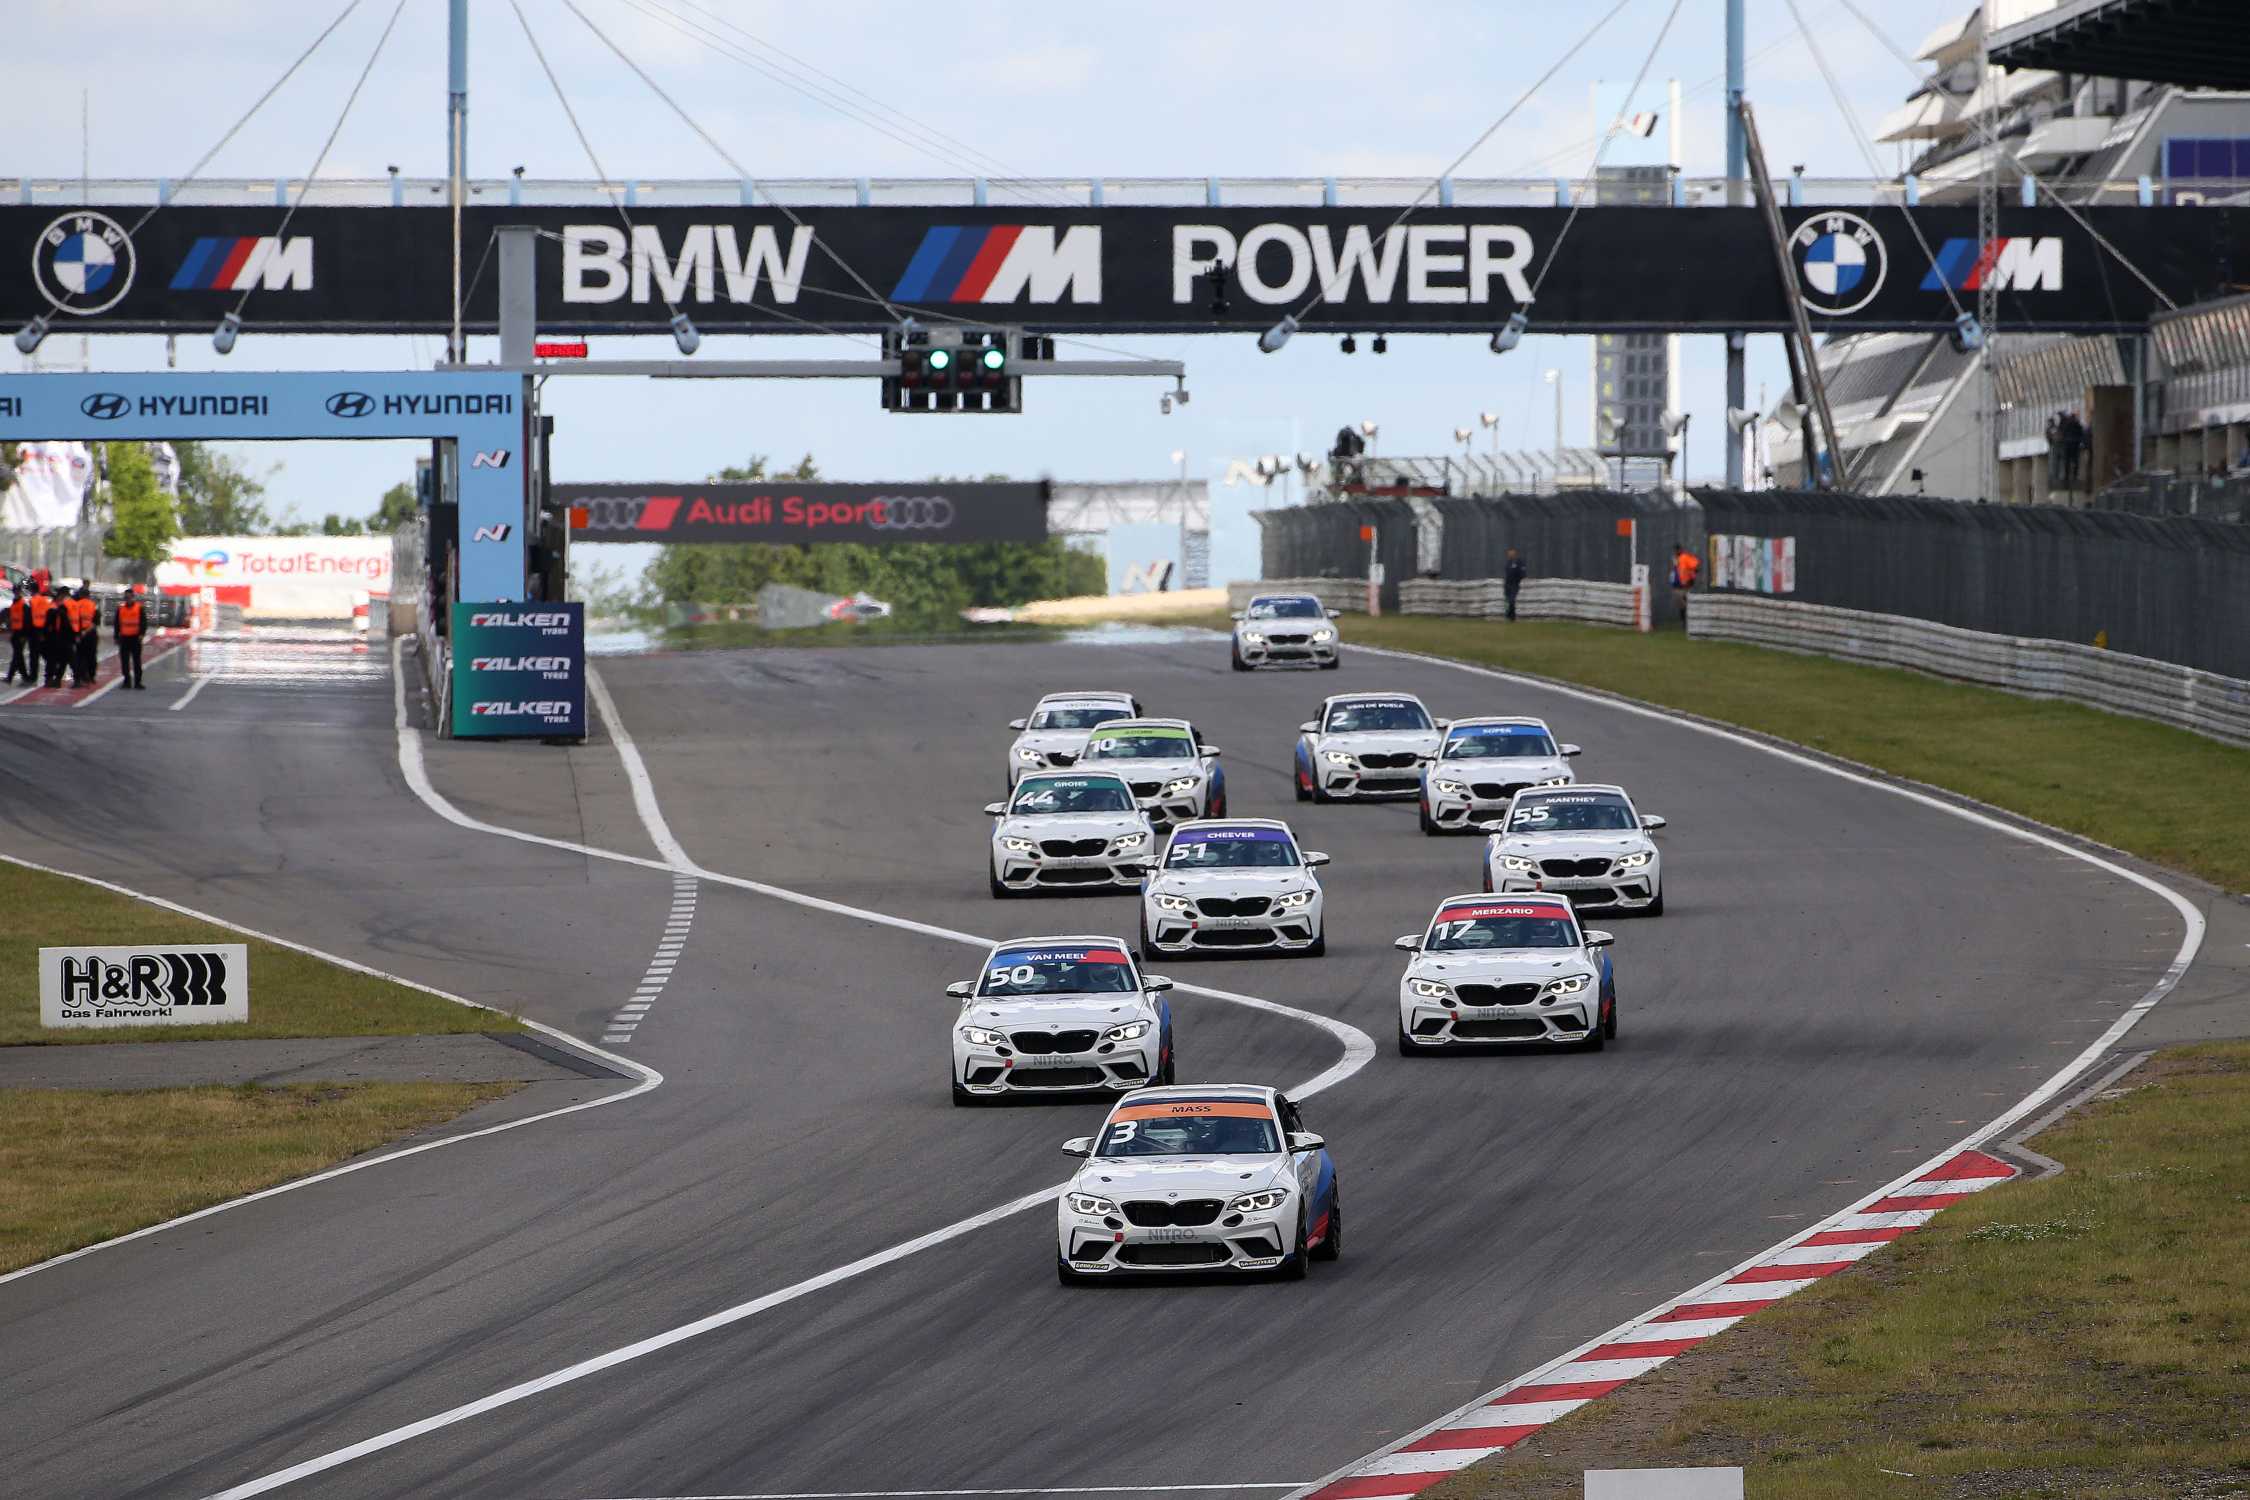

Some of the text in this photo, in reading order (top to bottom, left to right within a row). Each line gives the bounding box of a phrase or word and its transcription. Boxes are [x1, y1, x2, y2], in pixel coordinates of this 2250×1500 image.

[47, 217, 123, 246] BMW
[1799, 217, 1873, 247] BMW
[230, 236, 313, 291] M
[562, 222, 1536, 305] BMW M POWER
[140, 396, 268, 416] HYUNDAI
[384, 393, 512, 415] HYUNDAI
[687, 496, 887, 528] Audi Sport
[470, 612, 571, 627] FALKEN
[471, 656, 572, 671] FALKEN
[471, 700, 572, 715] FALKEN
[1330, 711, 1348, 727] 2
[1089, 738, 1116, 753] 10
[1513, 805, 1550, 825] 55
[1207, 831, 1256, 839] CHEEVER
[1170, 842, 1208, 861] 51
[1471, 907, 1534, 917] MERZARIO
[1435, 919, 1477, 942] 17
[1026, 953, 1054, 961] VAN
[61, 955, 170, 1007] H&R
[988, 965, 1035, 988] 50
[61, 1007, 173, 1019] Das Fahrwerk!
[1171, 1105, 1212, 1114] MASS
[1109, 1121, 1138, 1145] 3
